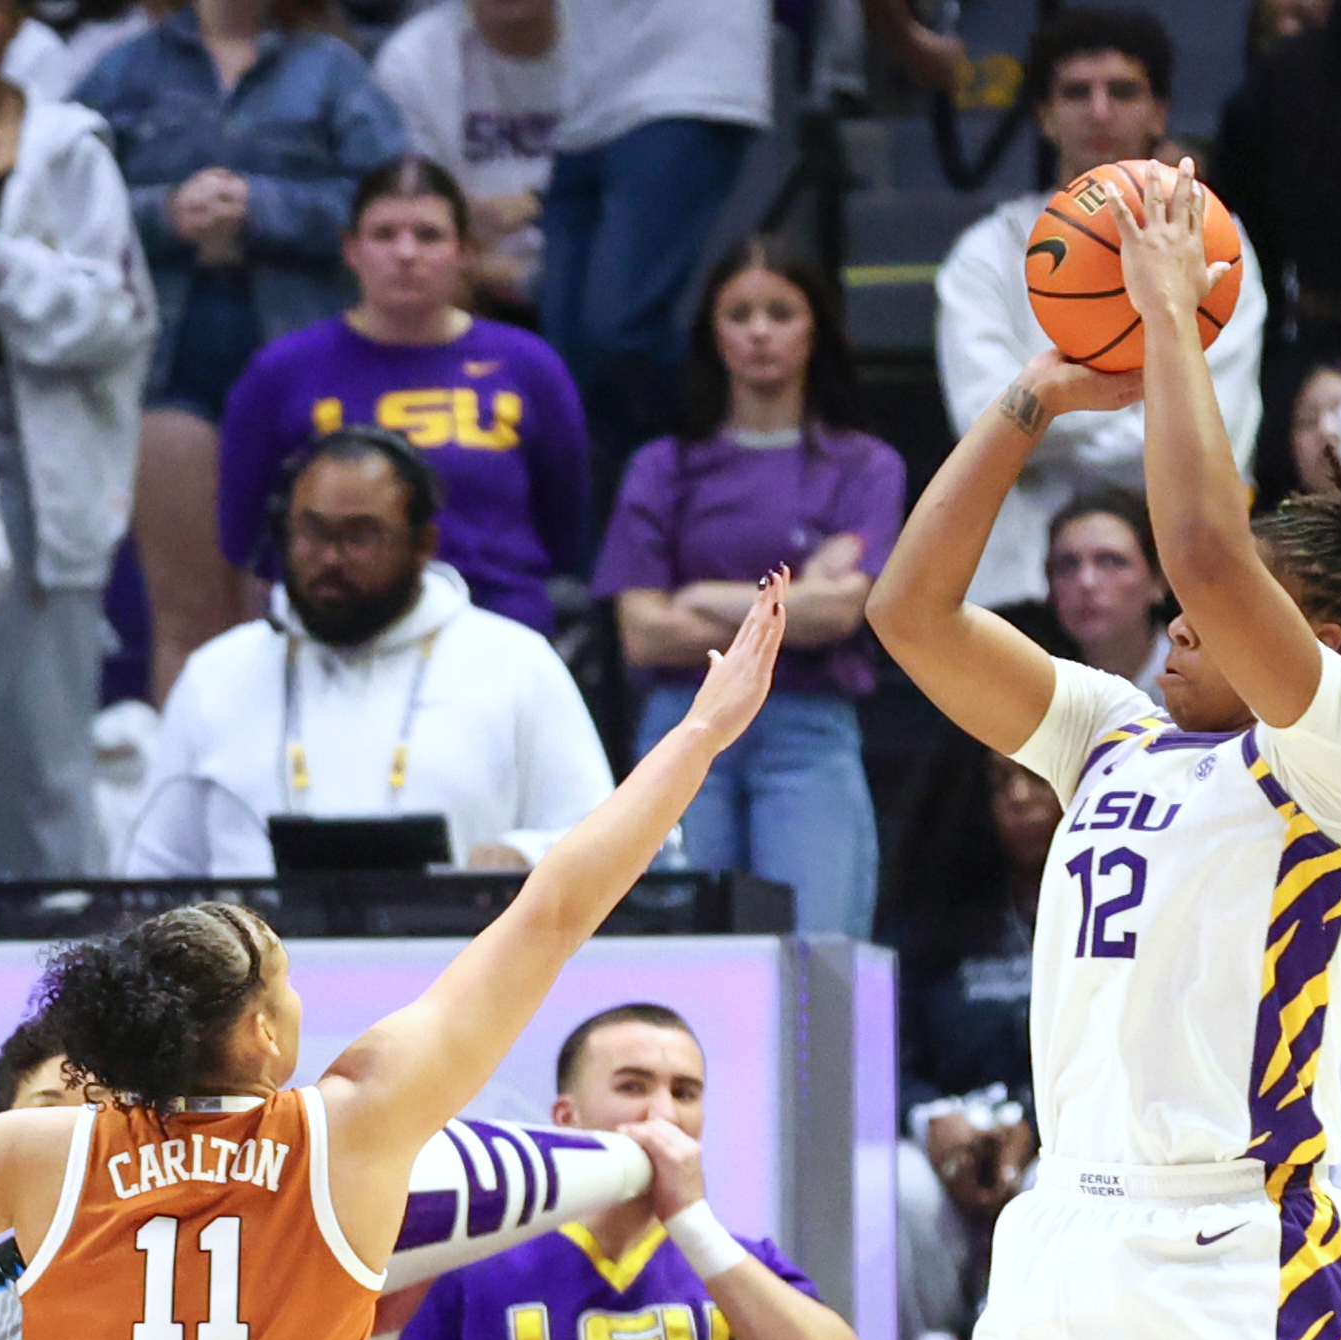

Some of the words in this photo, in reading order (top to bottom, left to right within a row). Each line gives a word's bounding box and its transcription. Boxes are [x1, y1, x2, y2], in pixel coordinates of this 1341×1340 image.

[1068, 791, 1182, 833] LSU
[1065, 846, 1148, 959] 12
[107, 1133, 290, 1199] CARLTON
[1080, 1173, 1120, 1185] GEAUX
[1079, 1185, 1125, 1197] TIGERS
